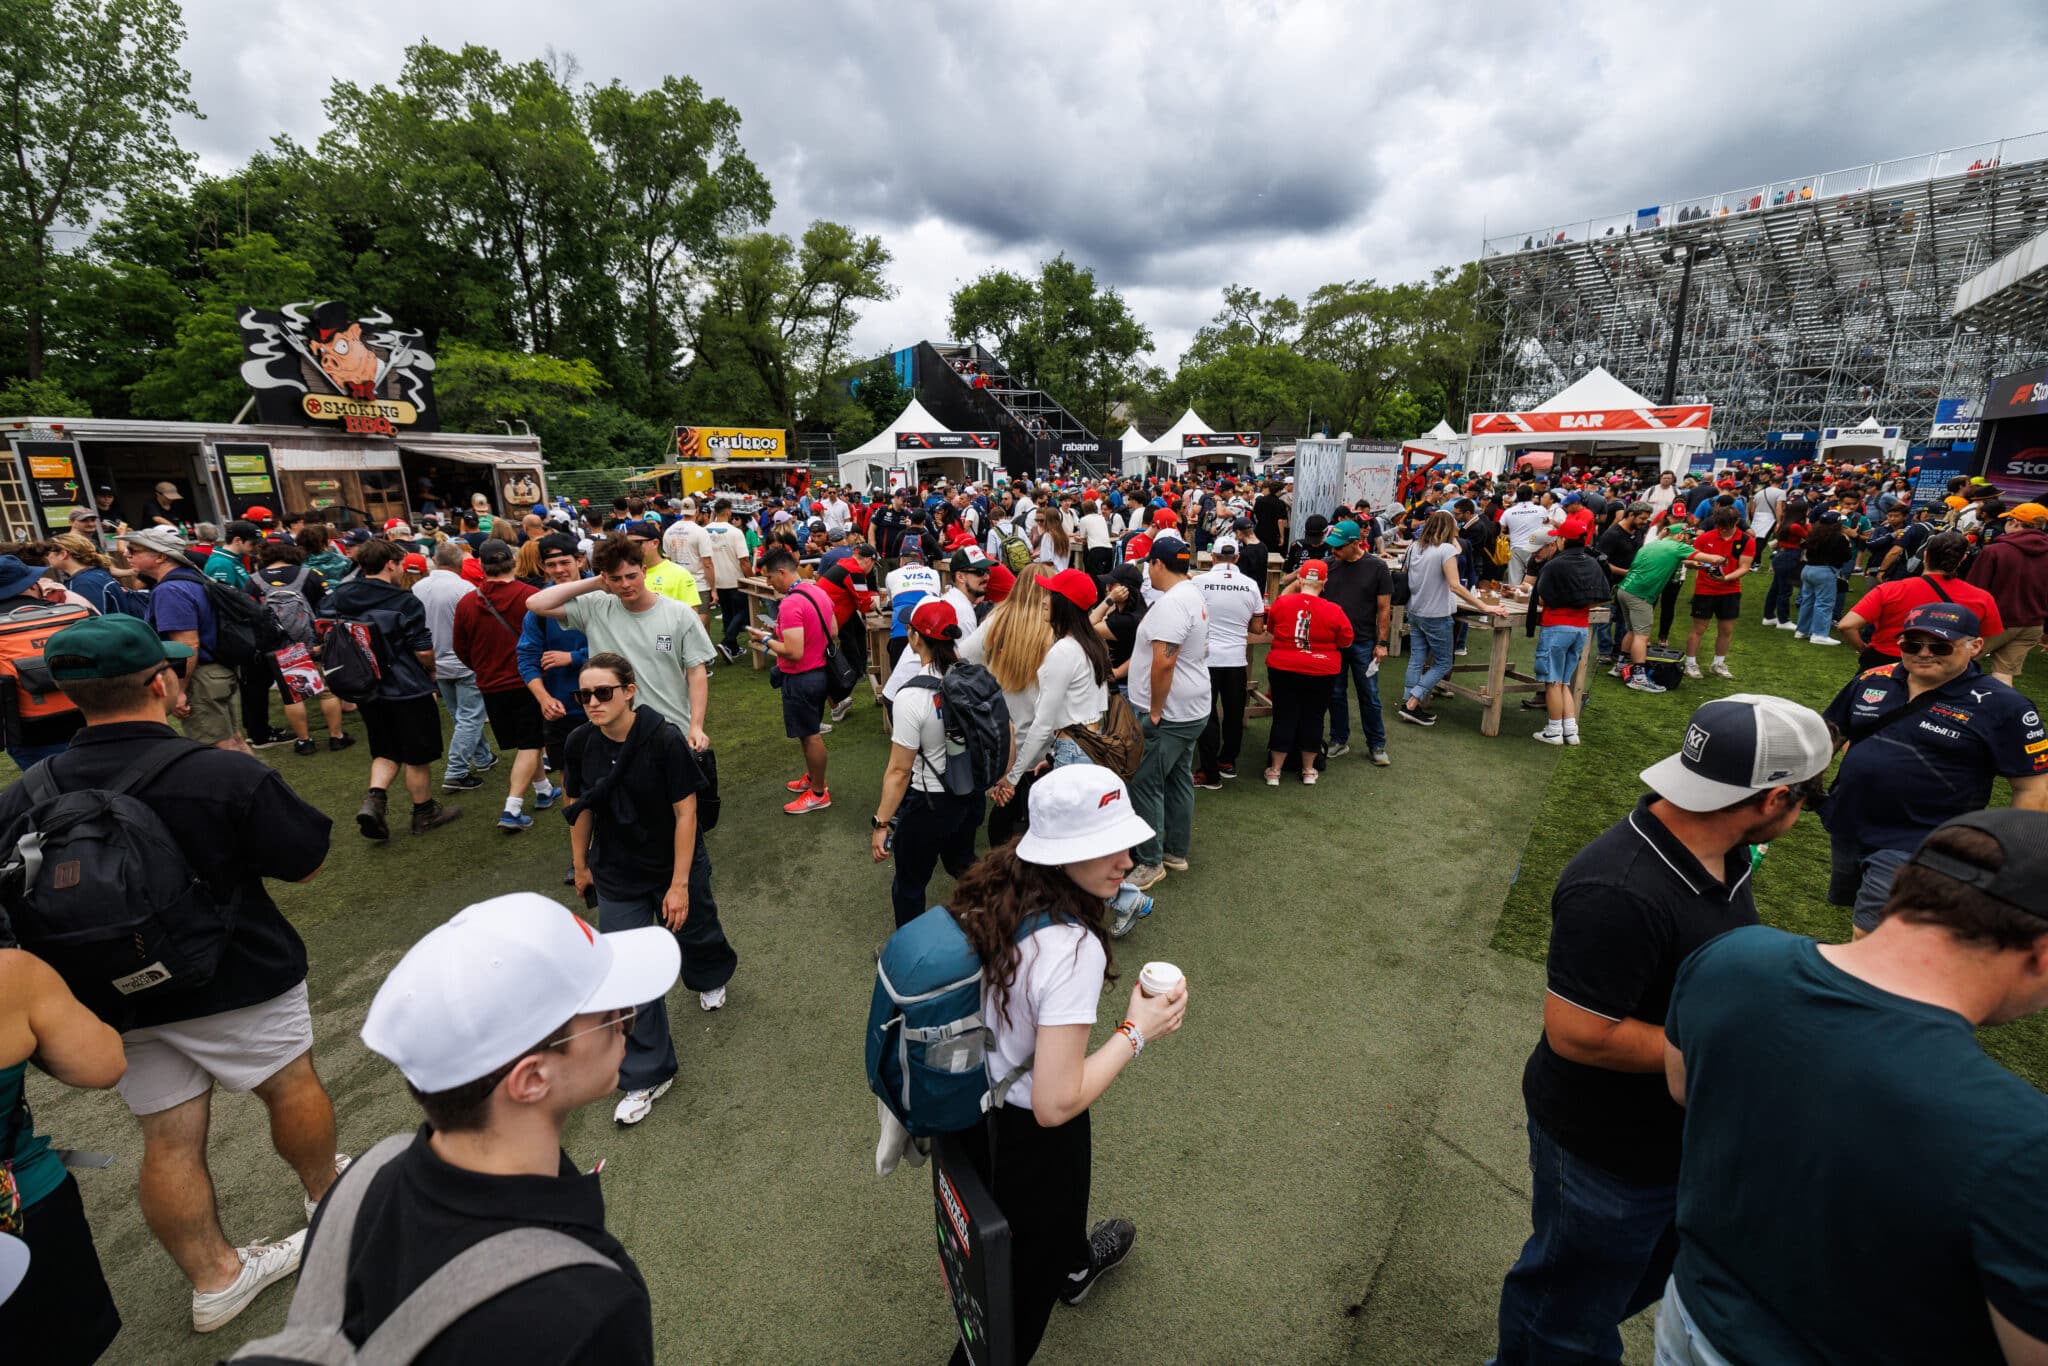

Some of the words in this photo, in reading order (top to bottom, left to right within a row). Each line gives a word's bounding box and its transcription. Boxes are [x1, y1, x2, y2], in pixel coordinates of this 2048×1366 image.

[323, 401, 400, 418] SMOKING
[344, 415, 398, 435] BBQ
[1559, 413, 1604, 428] BAR
[1062, 442, 1099, 451] rabanne
[1204, 583, 1250, 592] PETRONAS
[1920, 721, 1948, 735] Mobil
